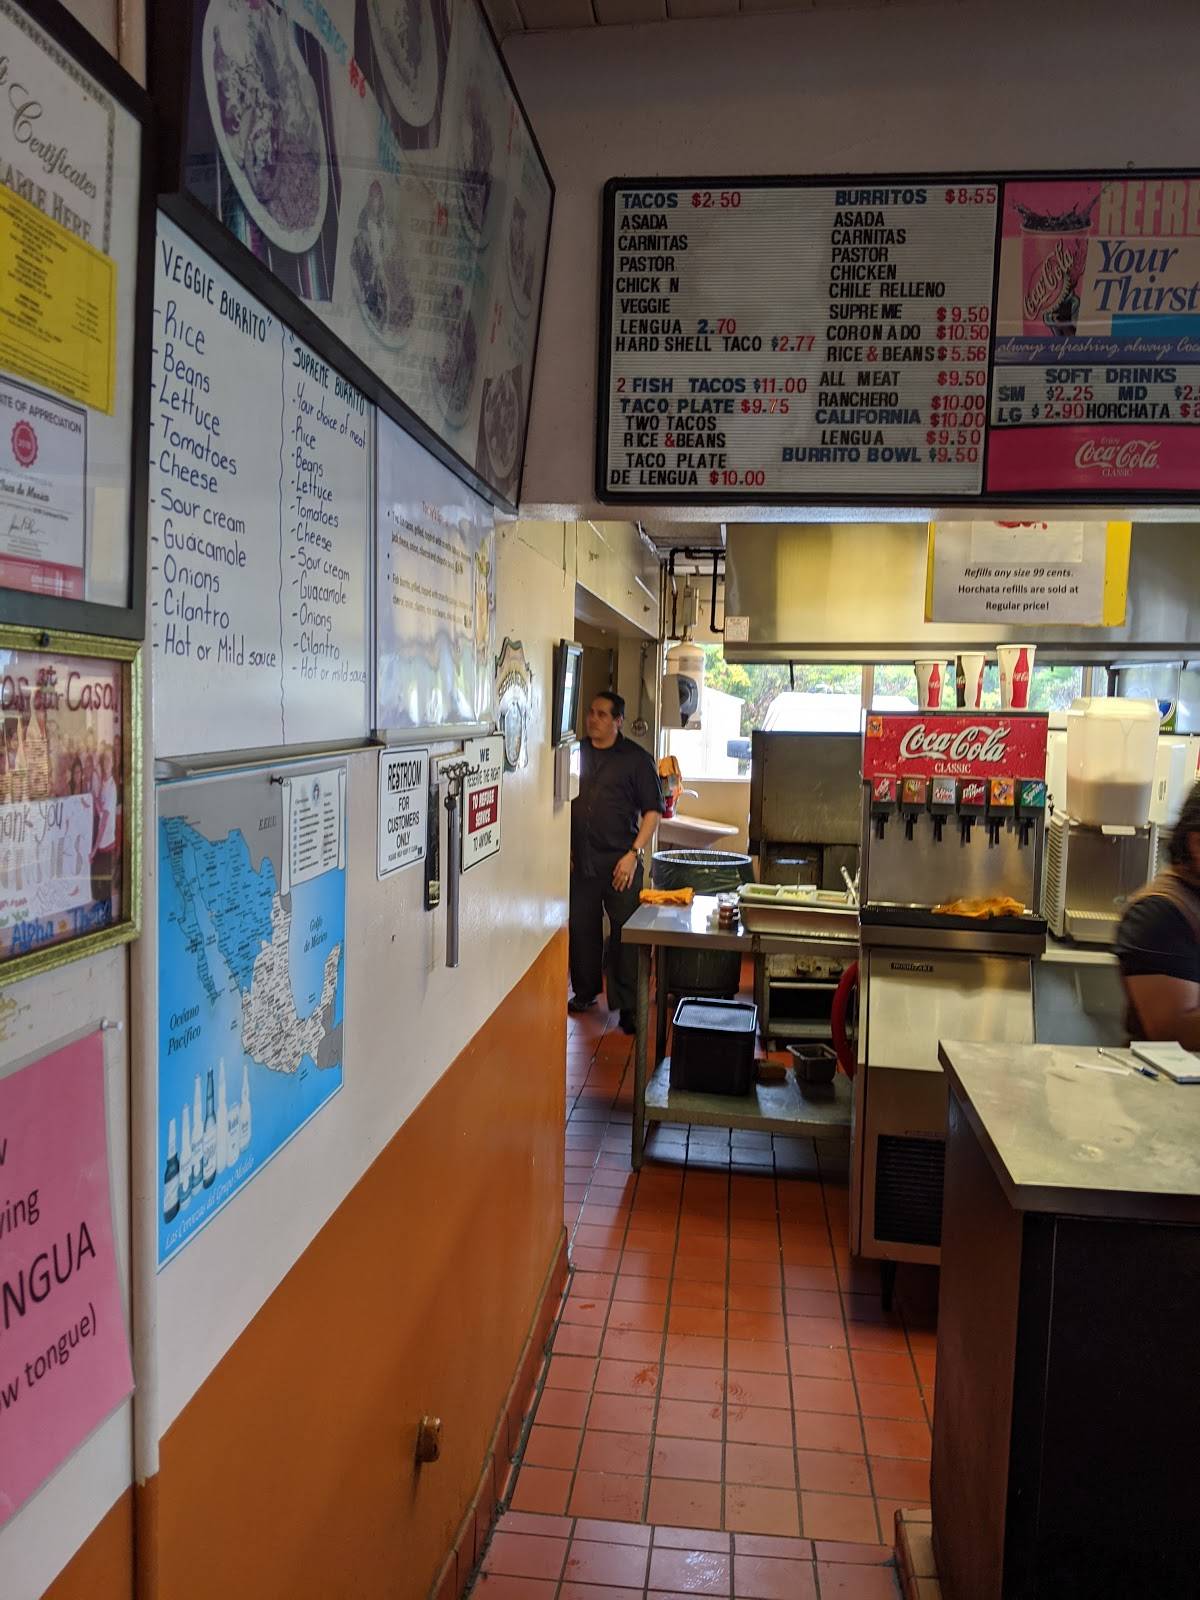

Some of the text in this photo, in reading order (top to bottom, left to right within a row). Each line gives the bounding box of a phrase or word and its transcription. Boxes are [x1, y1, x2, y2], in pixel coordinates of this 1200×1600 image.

[8, 83, 96, 198] Certificates
[622, 191, 741, 208] TACOS $2.50
[835, 188, 996, 206] BURRITOS $8.55
[620, 214, 668, 230] ASADA
[833, 211, 885, 227] ASADA
[618, 234, 688, 251] CARNITAS
[831, 229, 906, 245] CARNITAS
[620, 256, 675, 272] PASTOR
[831, 247, 889, 263] PASTOR
[1097, 240, 1179, 274] Your
[162, 240, 214, 304] VEGGIE
[830, 264, 897, 281] CHICKEN
[829, 282, 945, 299] CHILE RELLENO
[1094, 275, 1200, 312] Thirst
[621, 298, 671, 314] VEGGIE
[936, 307, 989, 323] $9.50
[165, 301, 205, 355] Rice
[620, 318, 736, 335] LENGUA 2.70
[826, 325, 989, 341] CORONADO $10.50
[615, 335, 815, 352] HARD SHELL TACO $2.77
[998, 338, 1044, 361] always
[1124, 337, 1172, 361] always
[827, 347, 863, 362] RICE
[882, 347, 935, 362] BEANS
[937, 346, 987, 362] $5.56
[163, 343, 210, 393] Beans
[1046, 368, 1177, 384] SOFT DRINKS
[616, 377, 807, 393] 2 FISH TACOS $11.00
[819, 370, 986, 387] ALL MEAT $9.50
[818, 392, 985, 410] RANCHERO $10.00
[998, 386, 1025, 401] SM
[1047, 386, 1094, 401] $2.25
[1118, 386, 1147, 401] MD
[159, 374, 221, 436] Lettuce
[620, 399, 789, 415] TACO PLATE $9.75
[998, 403, 1170, 423] LG $2.90 HORCHATA
[15, 400, 82, 434] OF APPRECIATION
[296, 383, 366, 449] Your choice of meat
[625, 415, 717, 431] TWO TACOS
[815, 409, 985, 428] CALIFORNIA $10.00
[295, 416, 316, 450] Rice
[623, 433, 658, 448] RICE
[821, 430, 981, 446] LENGUA $9.50
[161, 414, 237, 475] Tomatoes
[296, 446, 324, 478] Beans
[625, 453, 727, 469] TACO PLATE
[782, 447, 978, 463] BURRITO BOWL $9.50
[159, 450, 218, 493] Cheese
[610, 470, 765, 486] DE LENGUA $10.00
[1102, 469, 1133, 477] CLASSIC
[296, 473, 333, 502] Lettuce
[160, 488, 245, 534] Sour cream
[296, 497, 339, 528] Tomatoes
[164, 518, 247, 567] Guacamole
[297, 523, 332, 552] Cheese
[164, 554, 220, 592] Onions
[298, 547, 350, 582] Sour cream
[964, 568, 1074, 579] Refills any size 99 cents.
[300, 570, 347, 605] Guacamole
[958, 584, 1078, 594] Horchata refills are sold at
[164, 588, 230, 629] Cilantro
[985, 601, 1049, 611] Regular price!
[300, 603, 332, 632] Onions
[164, 623, 191, 656] Hot
[197, 643, 211, 661] or
[217, 634, 244, 666] Mild
[300, 632, 340, 661] Cilantro
[301, 657, 318, 680] Hot
[320, 666, 331, 680] or
[479, 748, 490, 763] WE
[387, 759, 422, 792] RESTROOM
[935, 762, 971, 774] CLASSIC
[398, 796, 410, 812] FOR
[473, 789, 495, 811] TO REFUSE
[387, 811, 420, 834] CUSTOMERS
[475, 808, 491, 828] SERVICE
[396, 832, 411, 849] ONLY
[473, 831, 492, 852] TO ANYONE
[167, 1025, 202, 1056] Pacífico
[25, 1302, 96, 1388] tongue)
